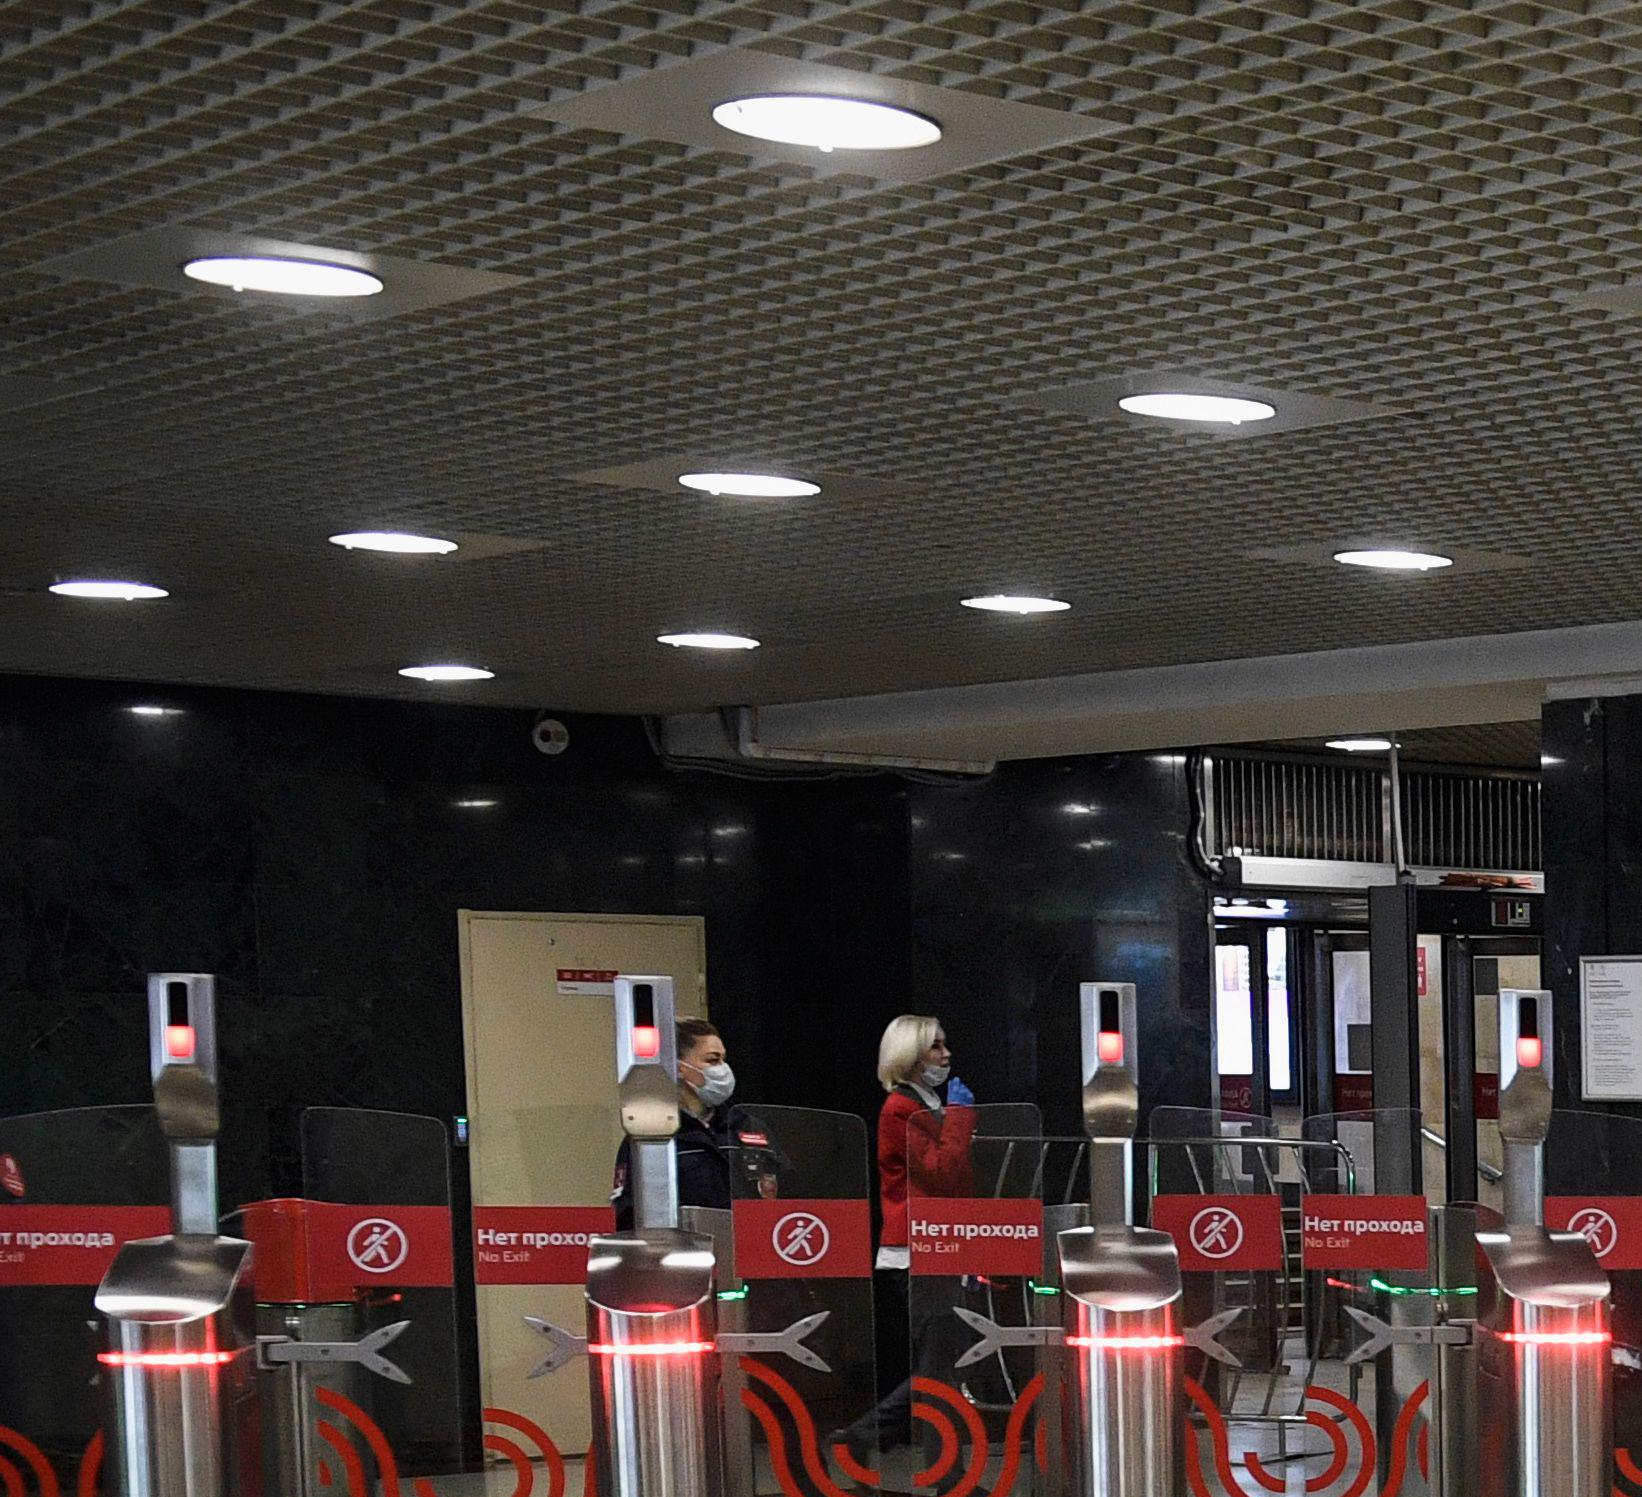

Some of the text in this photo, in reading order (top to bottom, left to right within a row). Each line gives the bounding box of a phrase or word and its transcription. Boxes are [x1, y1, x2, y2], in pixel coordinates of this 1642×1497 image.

[912, 1220, 1038, 1240] Нет прохода
[1305, 1216, 1424, 1235] Нет прохода
[17, 1233, 115, 1248] прохода
[478, 1229, 519, 1245] Нет
[1305, 1237, 1350, 1247] No Exit
[912, 1242, 959, 1252] No Exit
[479, 1251, 530, 1262] No Exit
